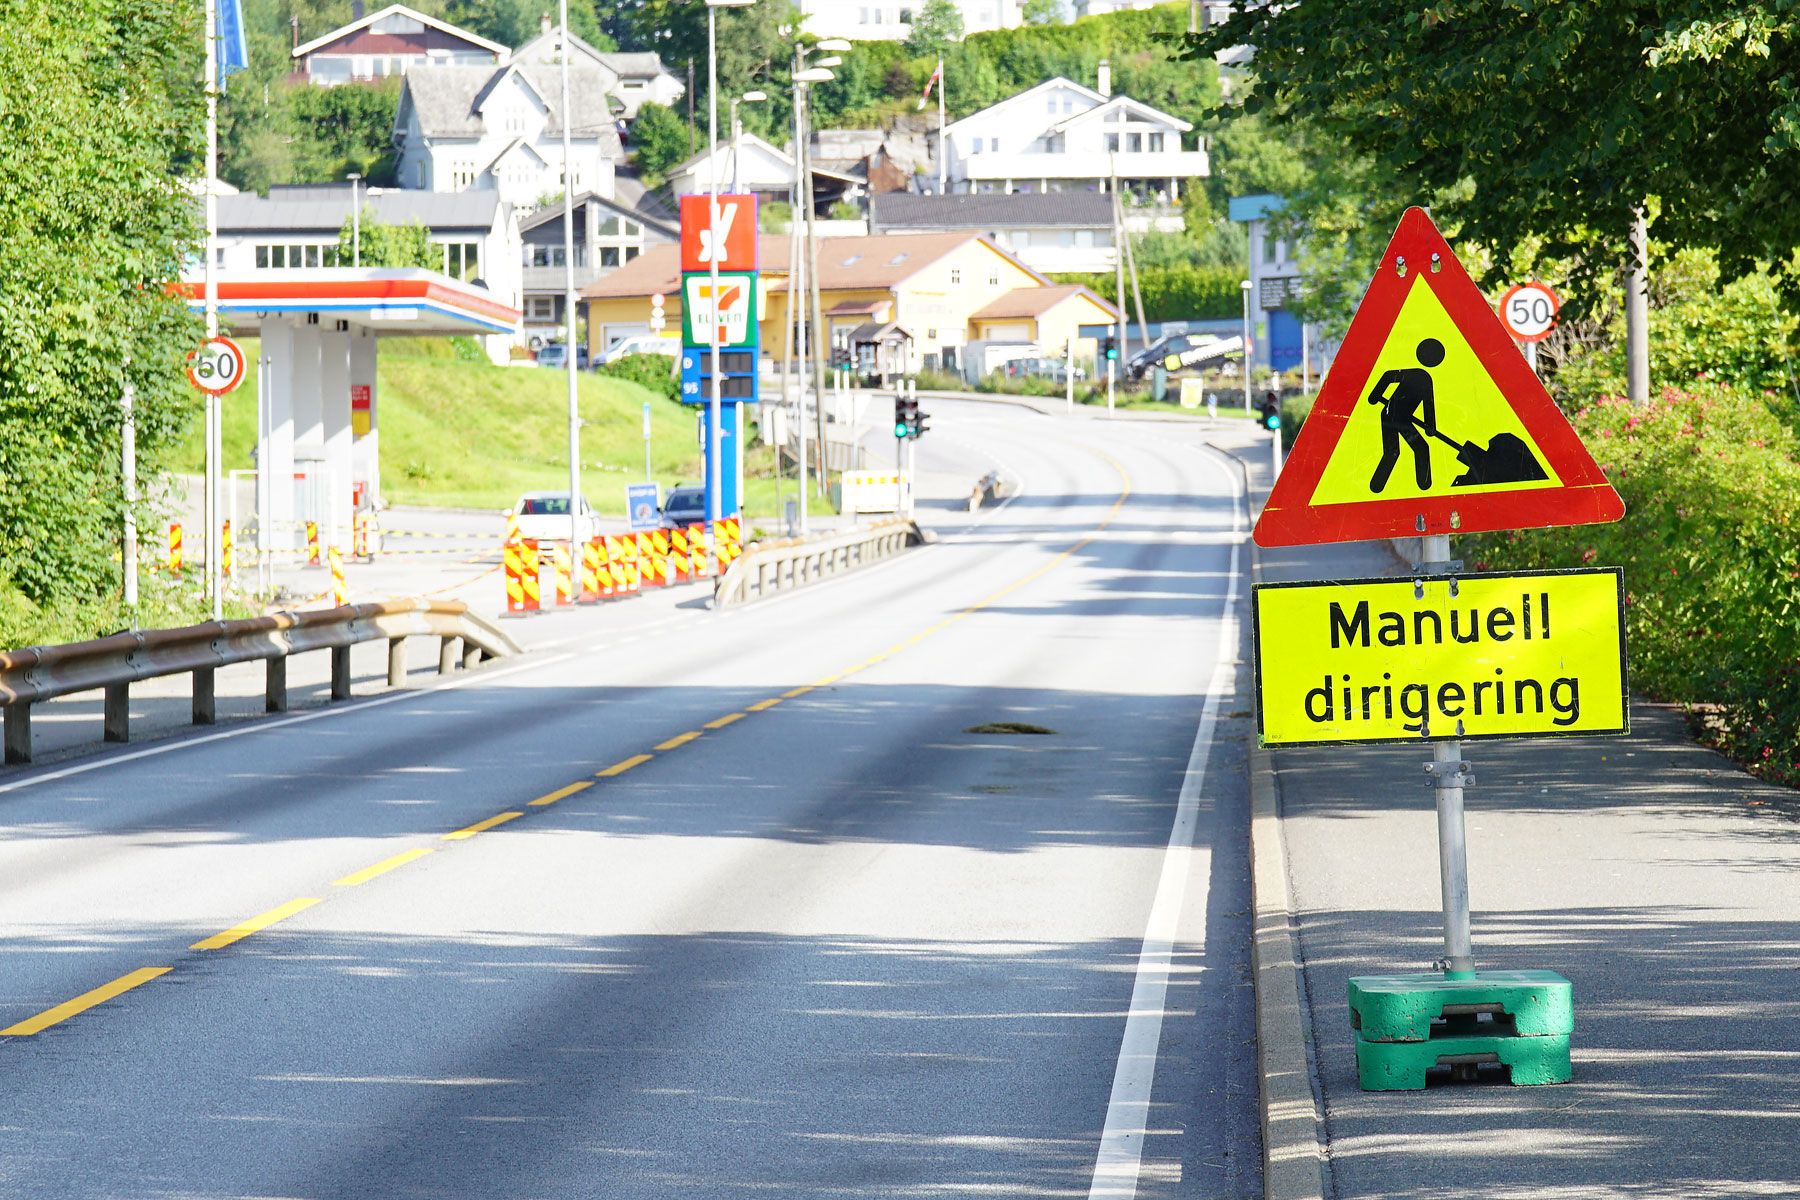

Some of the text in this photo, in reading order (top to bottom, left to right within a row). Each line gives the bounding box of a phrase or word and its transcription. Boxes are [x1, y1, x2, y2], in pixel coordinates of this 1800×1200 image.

[1513, 298, 1549, 325] 50
[1329, 592, 1550, 648] Manuell
[1304, 667, 1580, 732] dirigering
